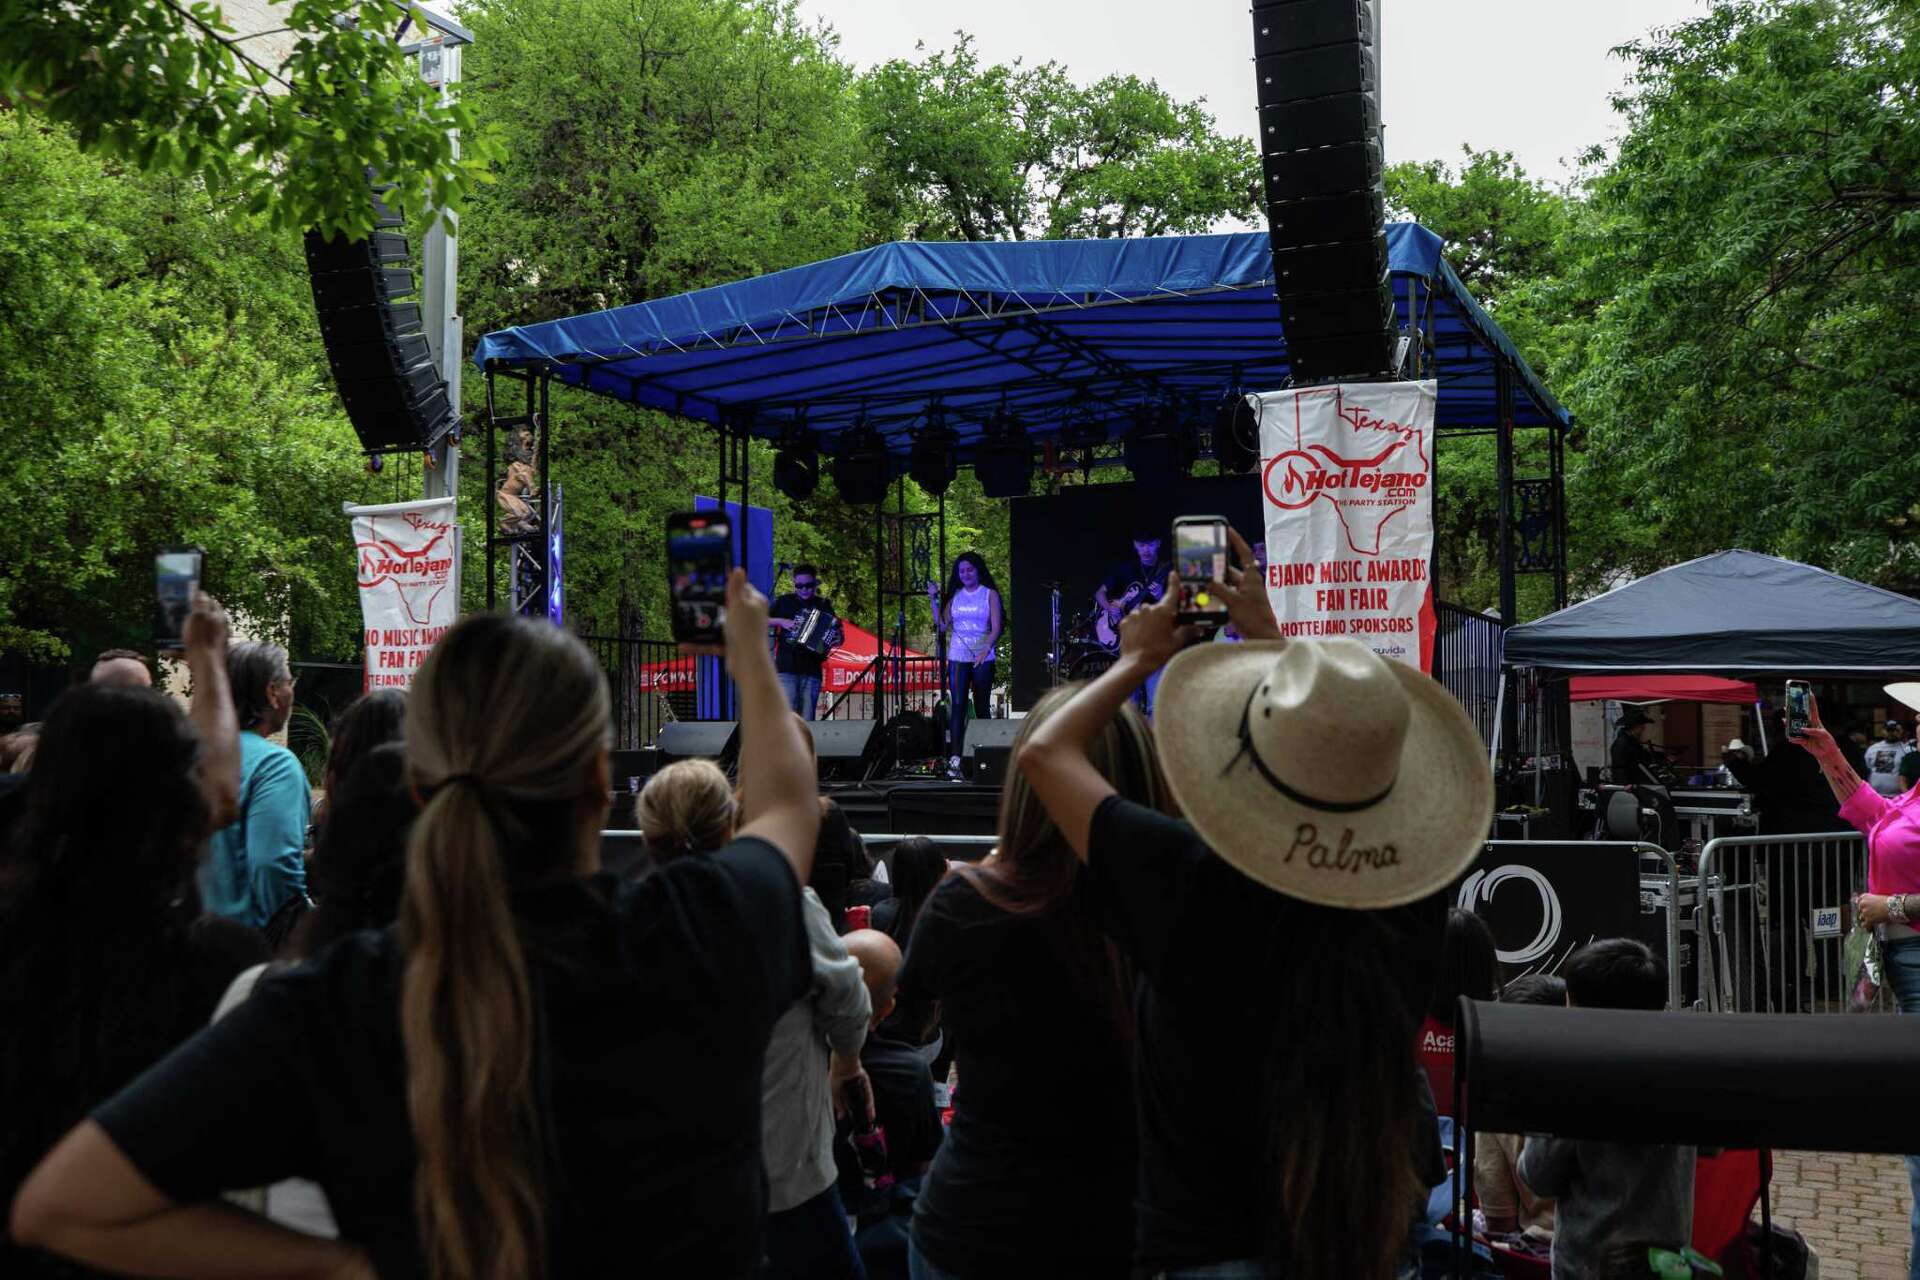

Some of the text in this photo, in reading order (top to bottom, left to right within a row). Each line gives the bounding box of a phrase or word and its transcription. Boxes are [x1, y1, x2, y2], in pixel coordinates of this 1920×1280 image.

[1344, 407, 1413, 441] Texas
[1305, 466, 1427, 493] HotTejano
[1377, 498, 1416, 506] STATION
[406, 512, 450, 534] Texas
[376, 557, 452, 577] HotTejan
[1269, 558, 1427, 587] EJANO MUSIC AWARDS
[1316, 588, 1389, 611] FAN FAIR
[383, 629, 419, 646] MUSIC
[1281, 616, 1413, 638] HOTTEJANO SPONSORS
[380, 650, 405, 668] FAN
[1372, 645, 1406, 655] suvida
[1283, 822, 1402, 873] Palma
[1424, 1031, 1455, 1047] Aca
